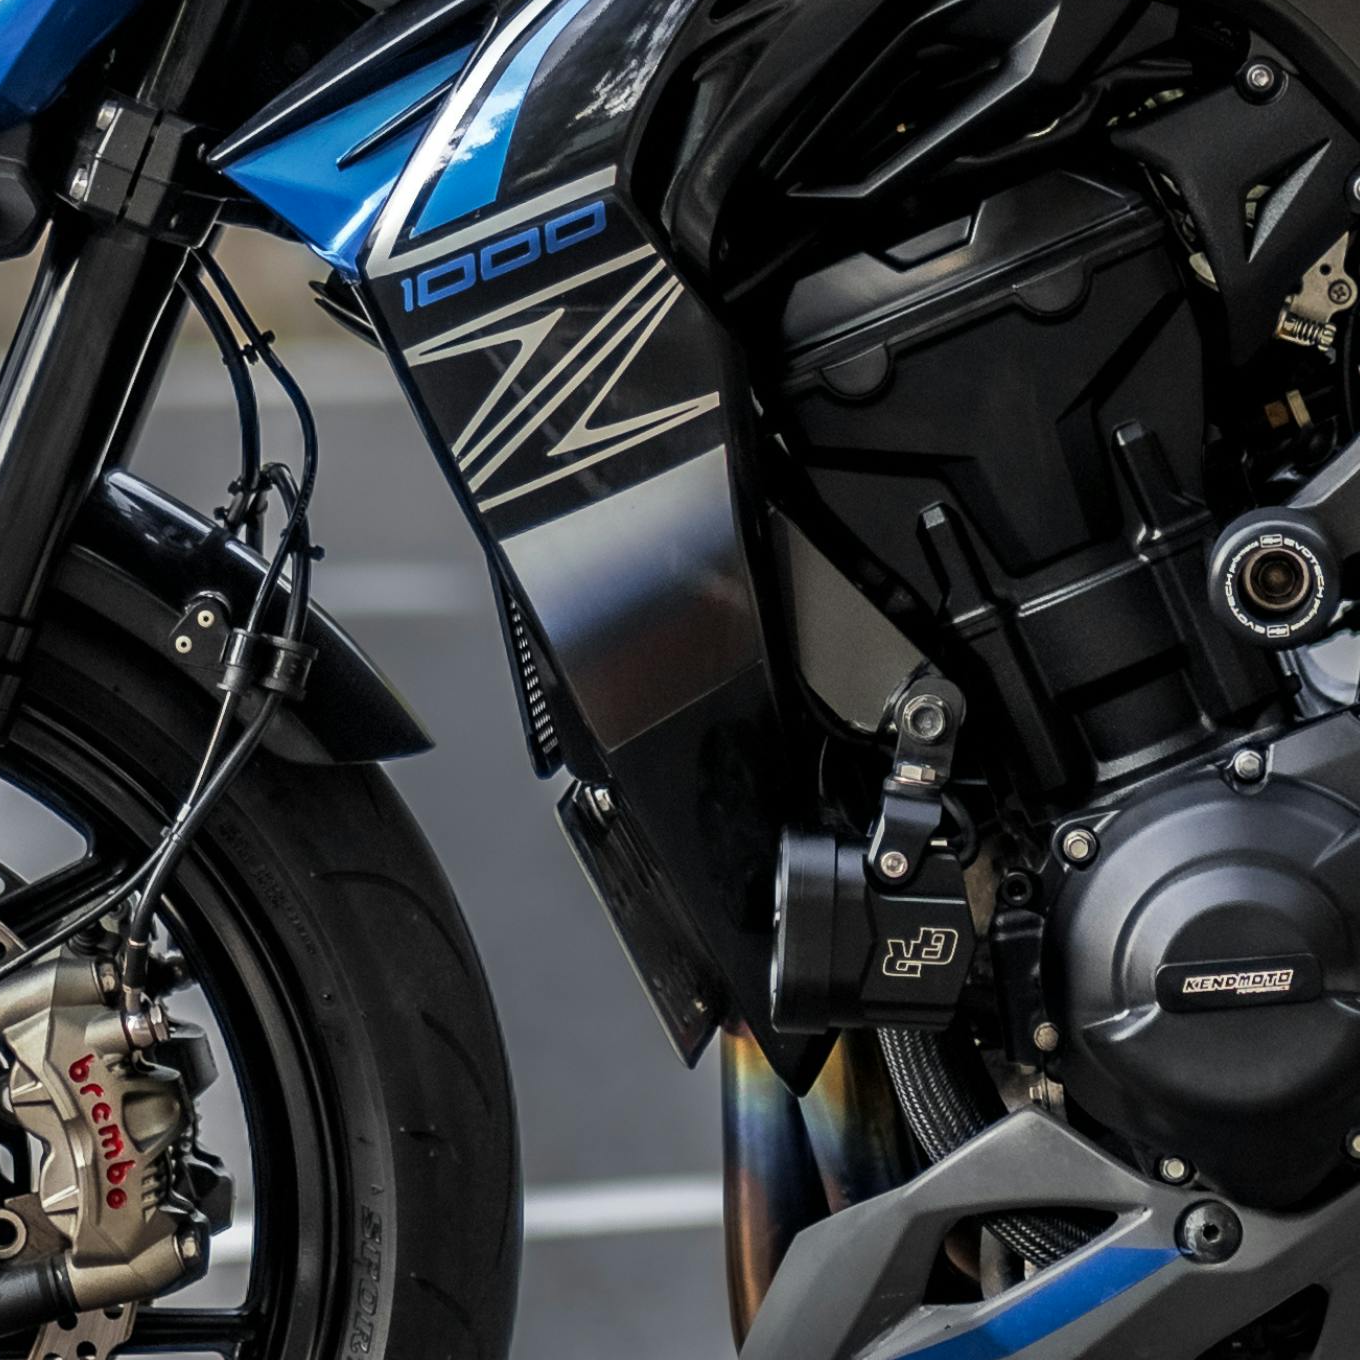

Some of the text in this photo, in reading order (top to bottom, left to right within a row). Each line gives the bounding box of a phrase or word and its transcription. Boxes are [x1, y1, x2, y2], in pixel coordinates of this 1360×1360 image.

[400, 200, 607, 312] 1000
[401, 242, 720, 513] Z
[1182, 969, 1293, 993] KENDMOTO
[68, 1053, 136, 1210] brembo
